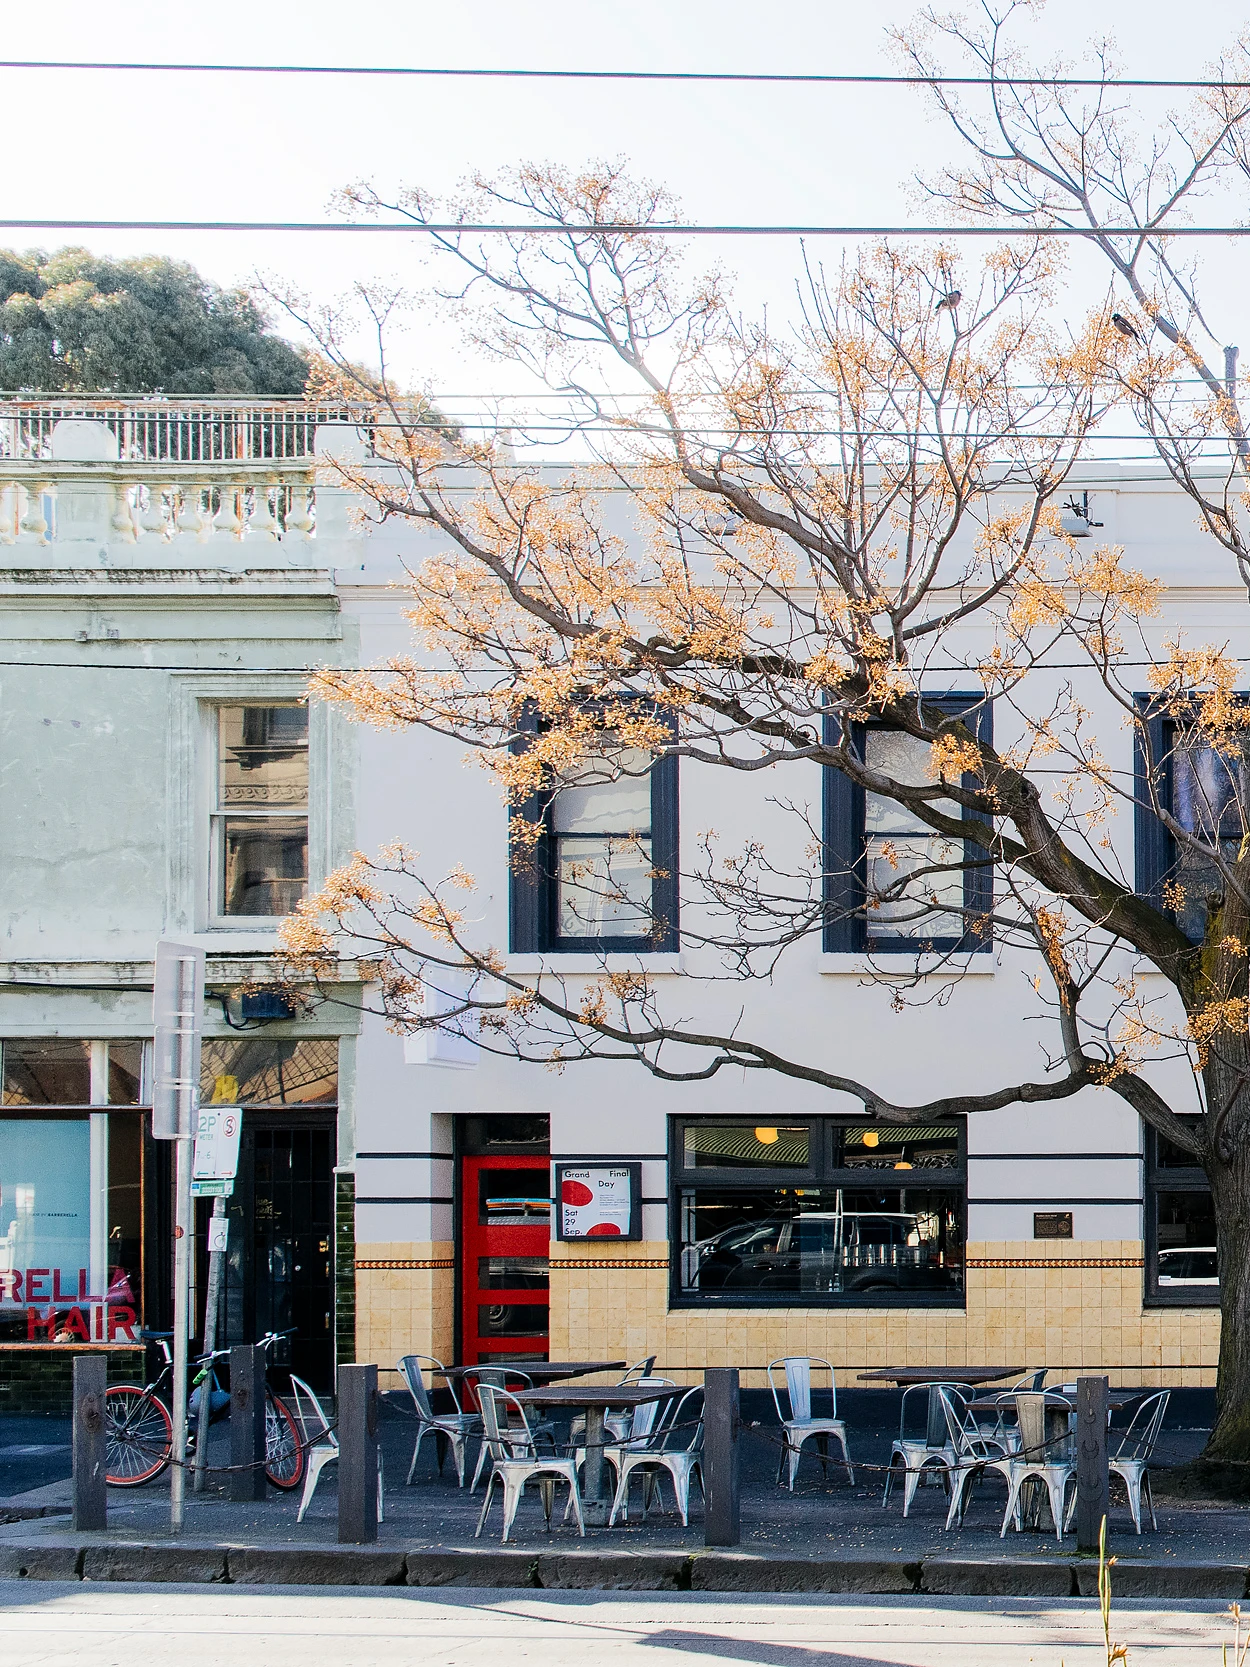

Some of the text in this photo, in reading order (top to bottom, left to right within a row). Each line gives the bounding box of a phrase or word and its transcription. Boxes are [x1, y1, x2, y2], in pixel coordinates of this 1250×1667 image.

[198, 1116, 216, 1132] 2P
[599, 1181, 615, 1189] Day
[565, 1228, 582, 1236] Sep.
[27, 1306, 136, 1341] HAIR
